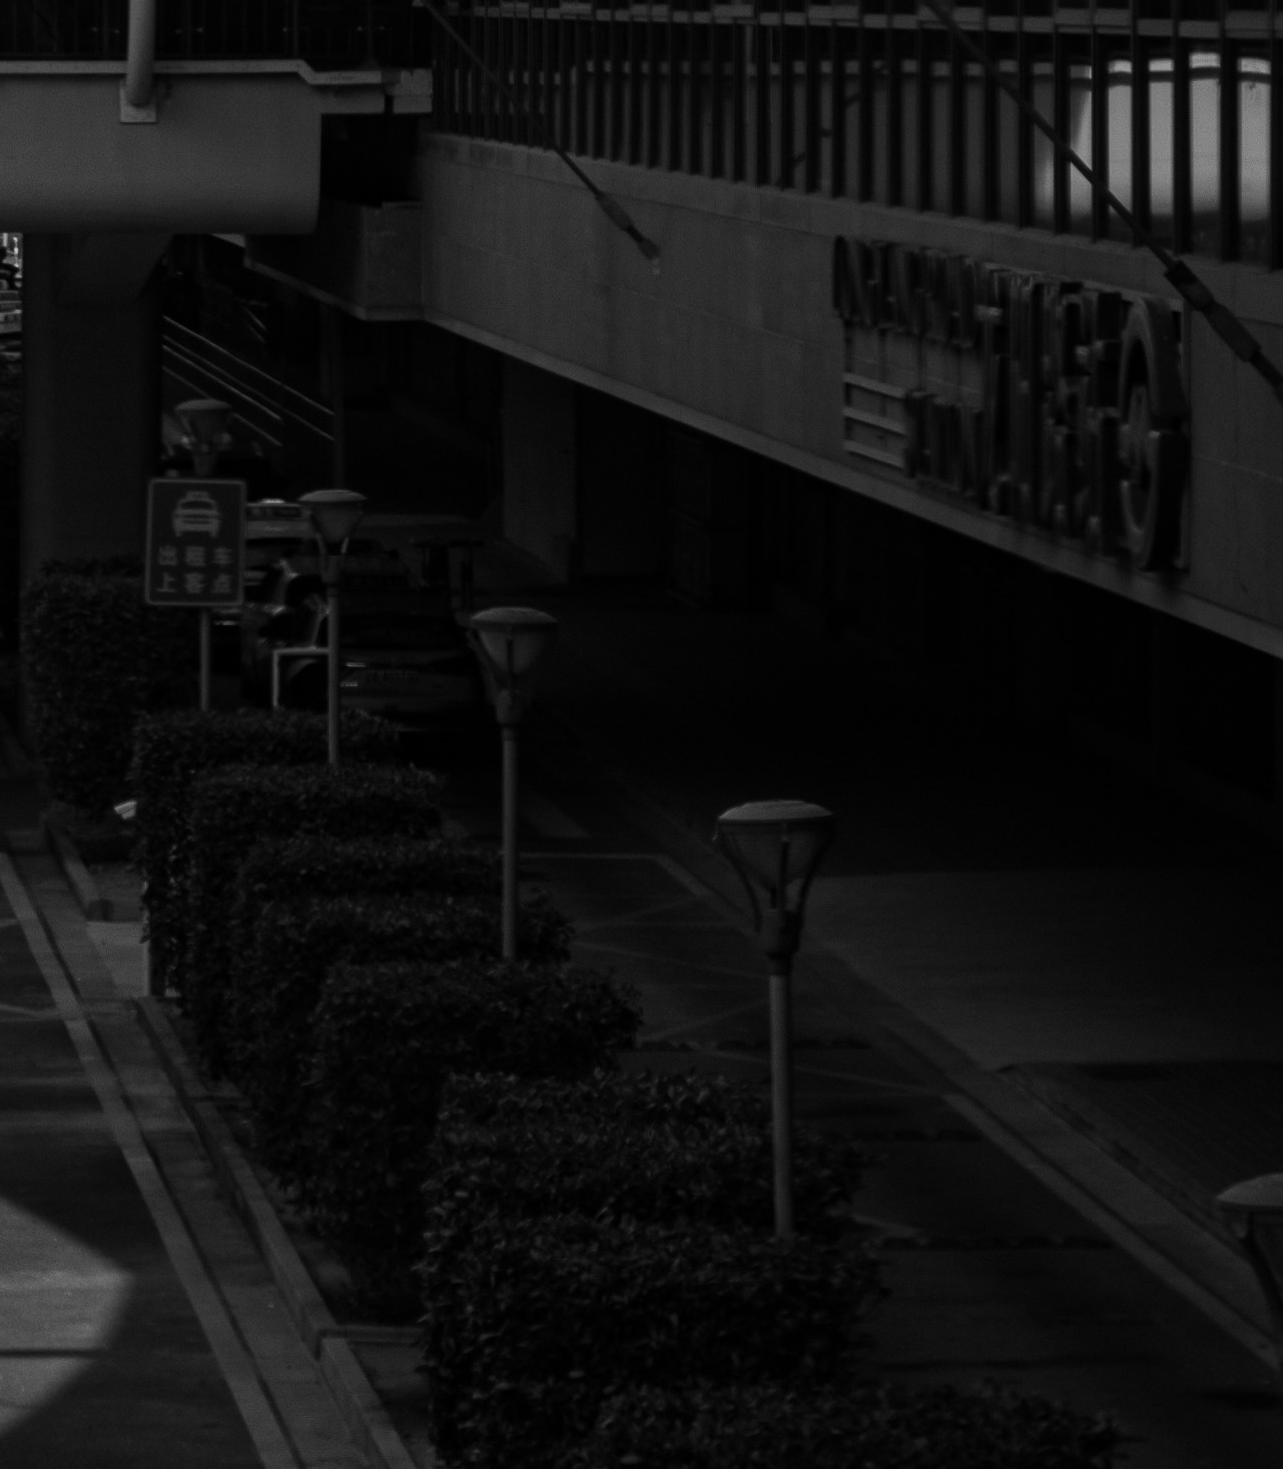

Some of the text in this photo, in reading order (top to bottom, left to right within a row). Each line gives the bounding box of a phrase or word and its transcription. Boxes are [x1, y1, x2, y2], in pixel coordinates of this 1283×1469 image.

[157, 545, 235, 568] 出租车
[155, 571, 233, 594] 上客点
